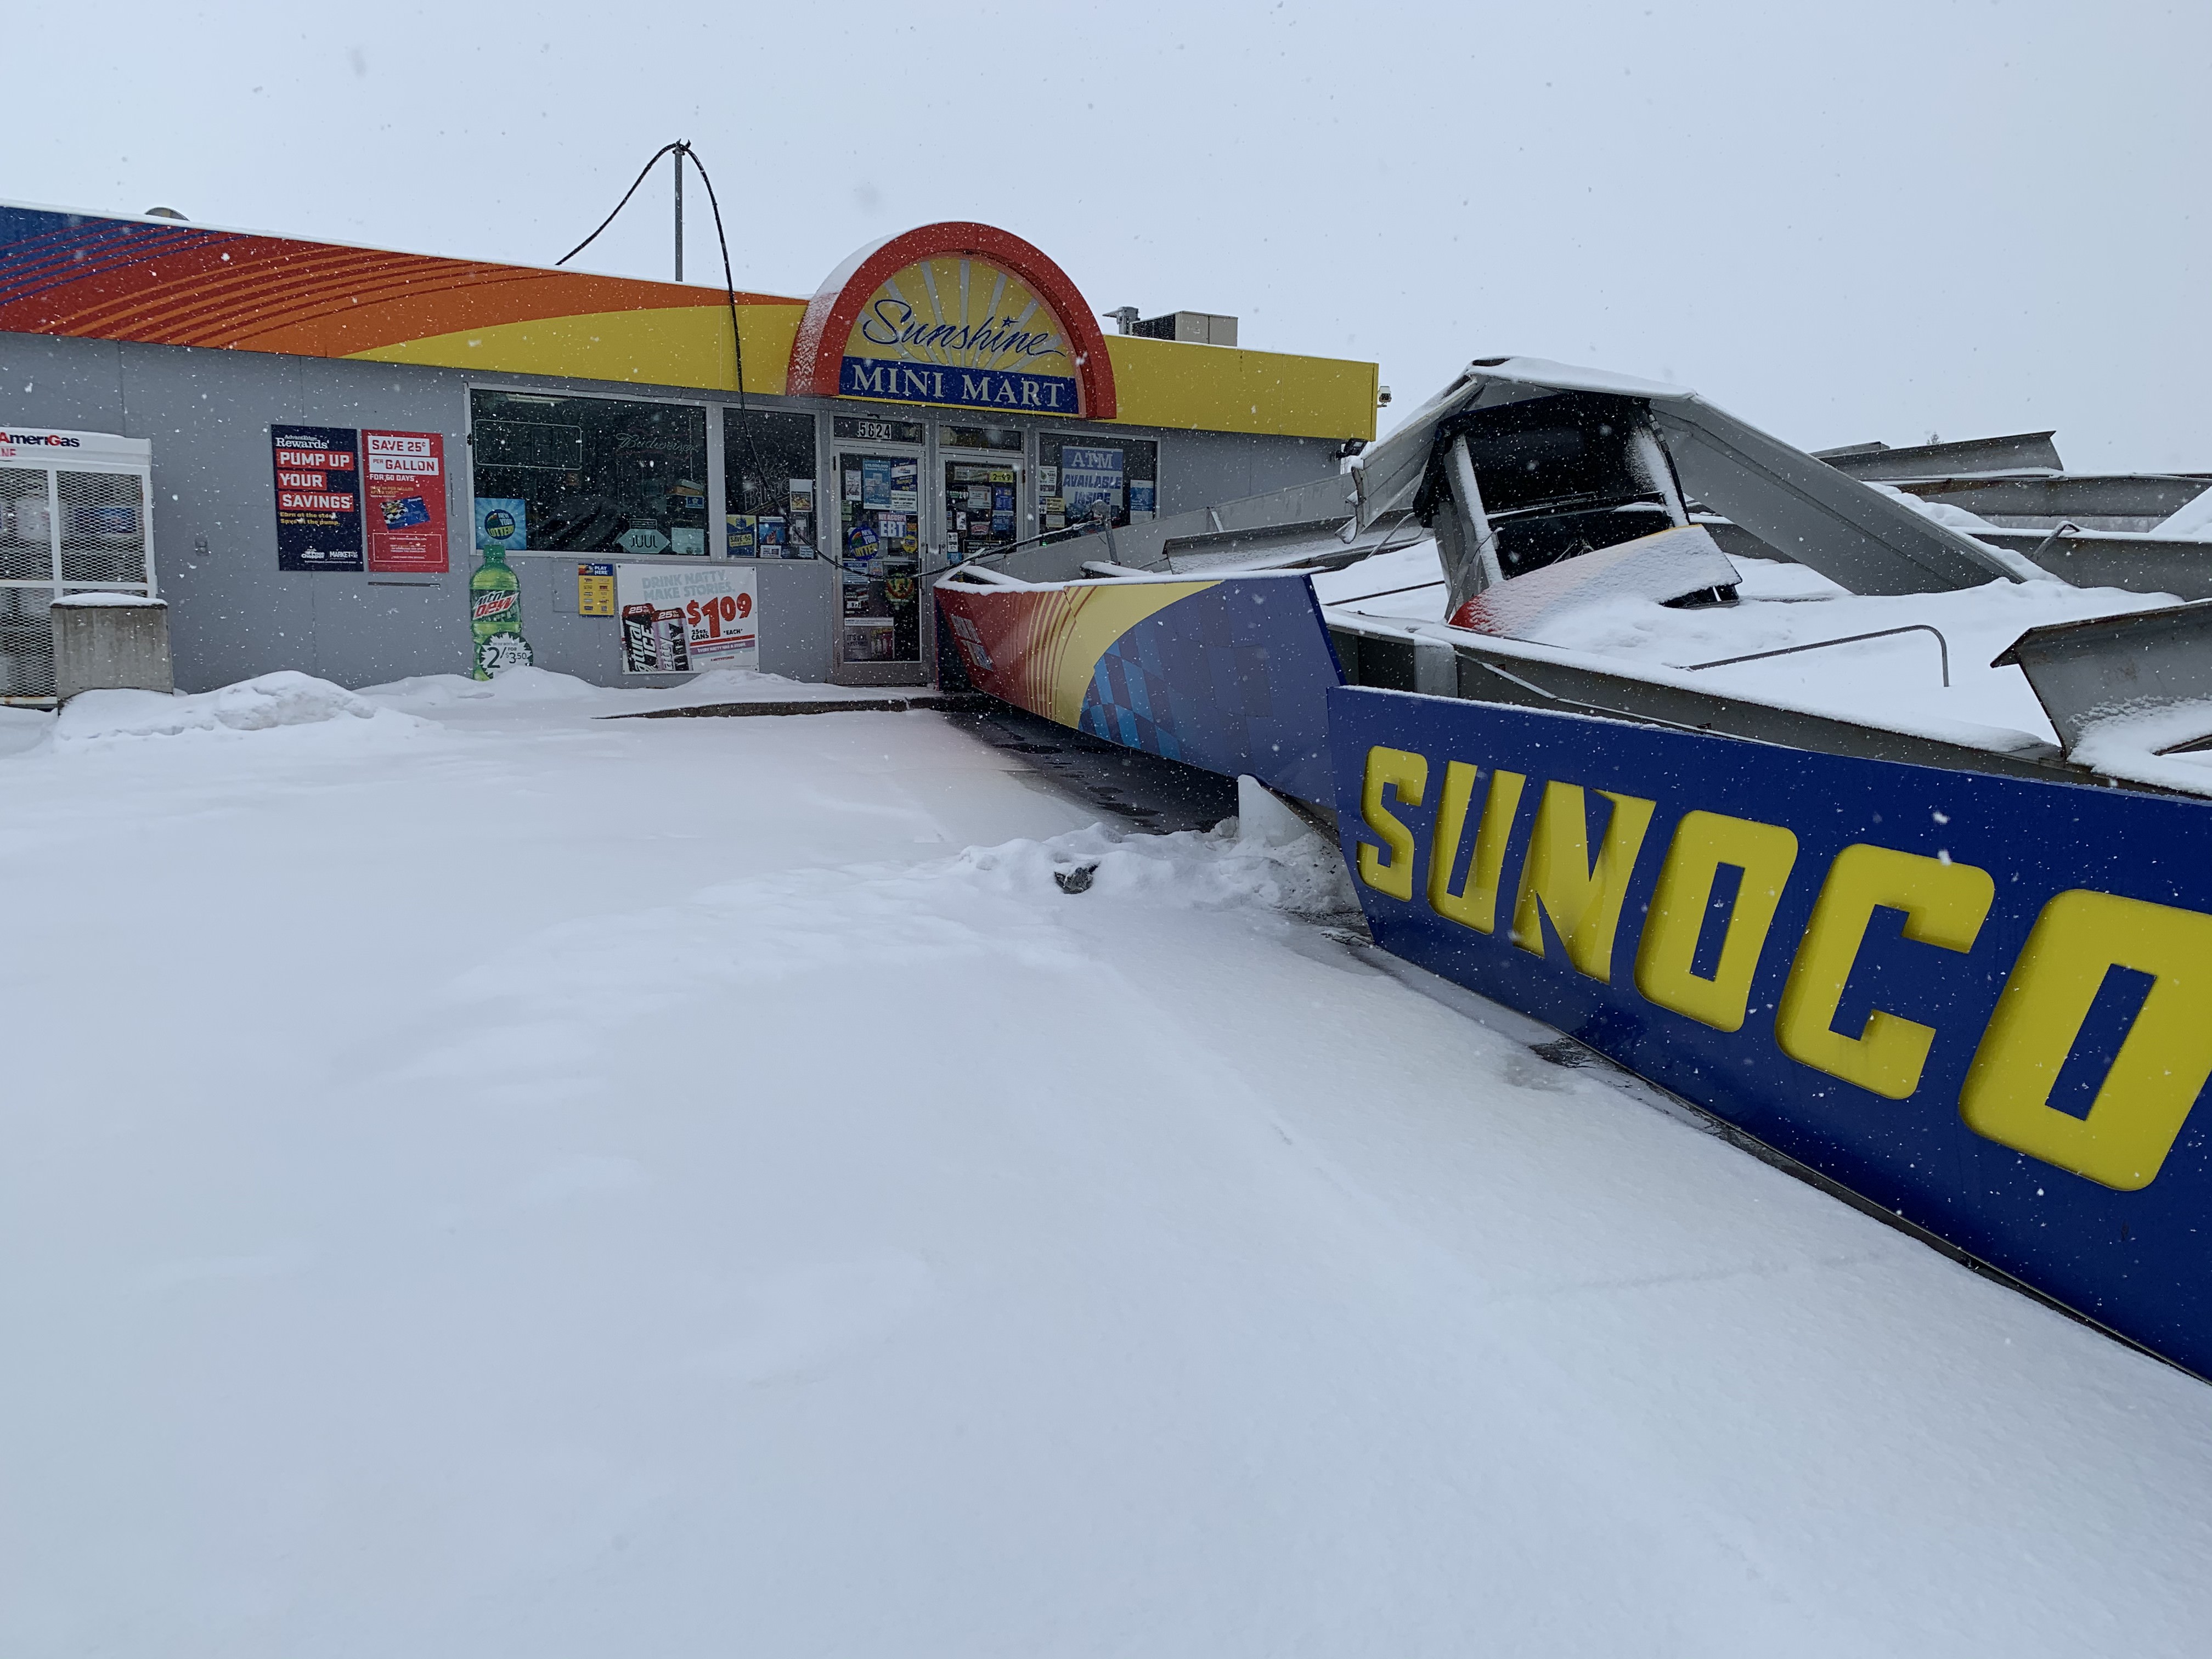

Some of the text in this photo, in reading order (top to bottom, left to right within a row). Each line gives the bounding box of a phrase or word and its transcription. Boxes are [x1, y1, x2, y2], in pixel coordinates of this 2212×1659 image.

[863, 299, 1065, 357] Sunshine
[853, 364, 1064, 408] MINI MART
[860, 422, 890, 438] 5824
[0, 432, 80, 447] AmeriGas
[275, 437, 328, 449] Rewards
[372, 440, 404, 451] SAVE
[616, 432, 695, 452] Budweiser
[280, 452, 349, 467] PUMP UP
[386, 459, 435, 471] GALLON
[1071, 452, 1113, 469] ATM
[280, 473, 323, 487] YOUR
[1063, 474, 1122, 489] AVAILABLE
[283, 494, 350, 509] SAVINGS
[1074, 491, 1111, 505] INSIDE
[881, 521, 905, 537] EBT
[631, 535, 658, 548] JUUL
[642, 574, 682, 589] DRINK
[643, 587, 681, 601] MAKE
[658, 611, 673, 619] 25
[641, 624, 657, 658] ICE
[1356, 744, 2212, 1191] SUNOCO
